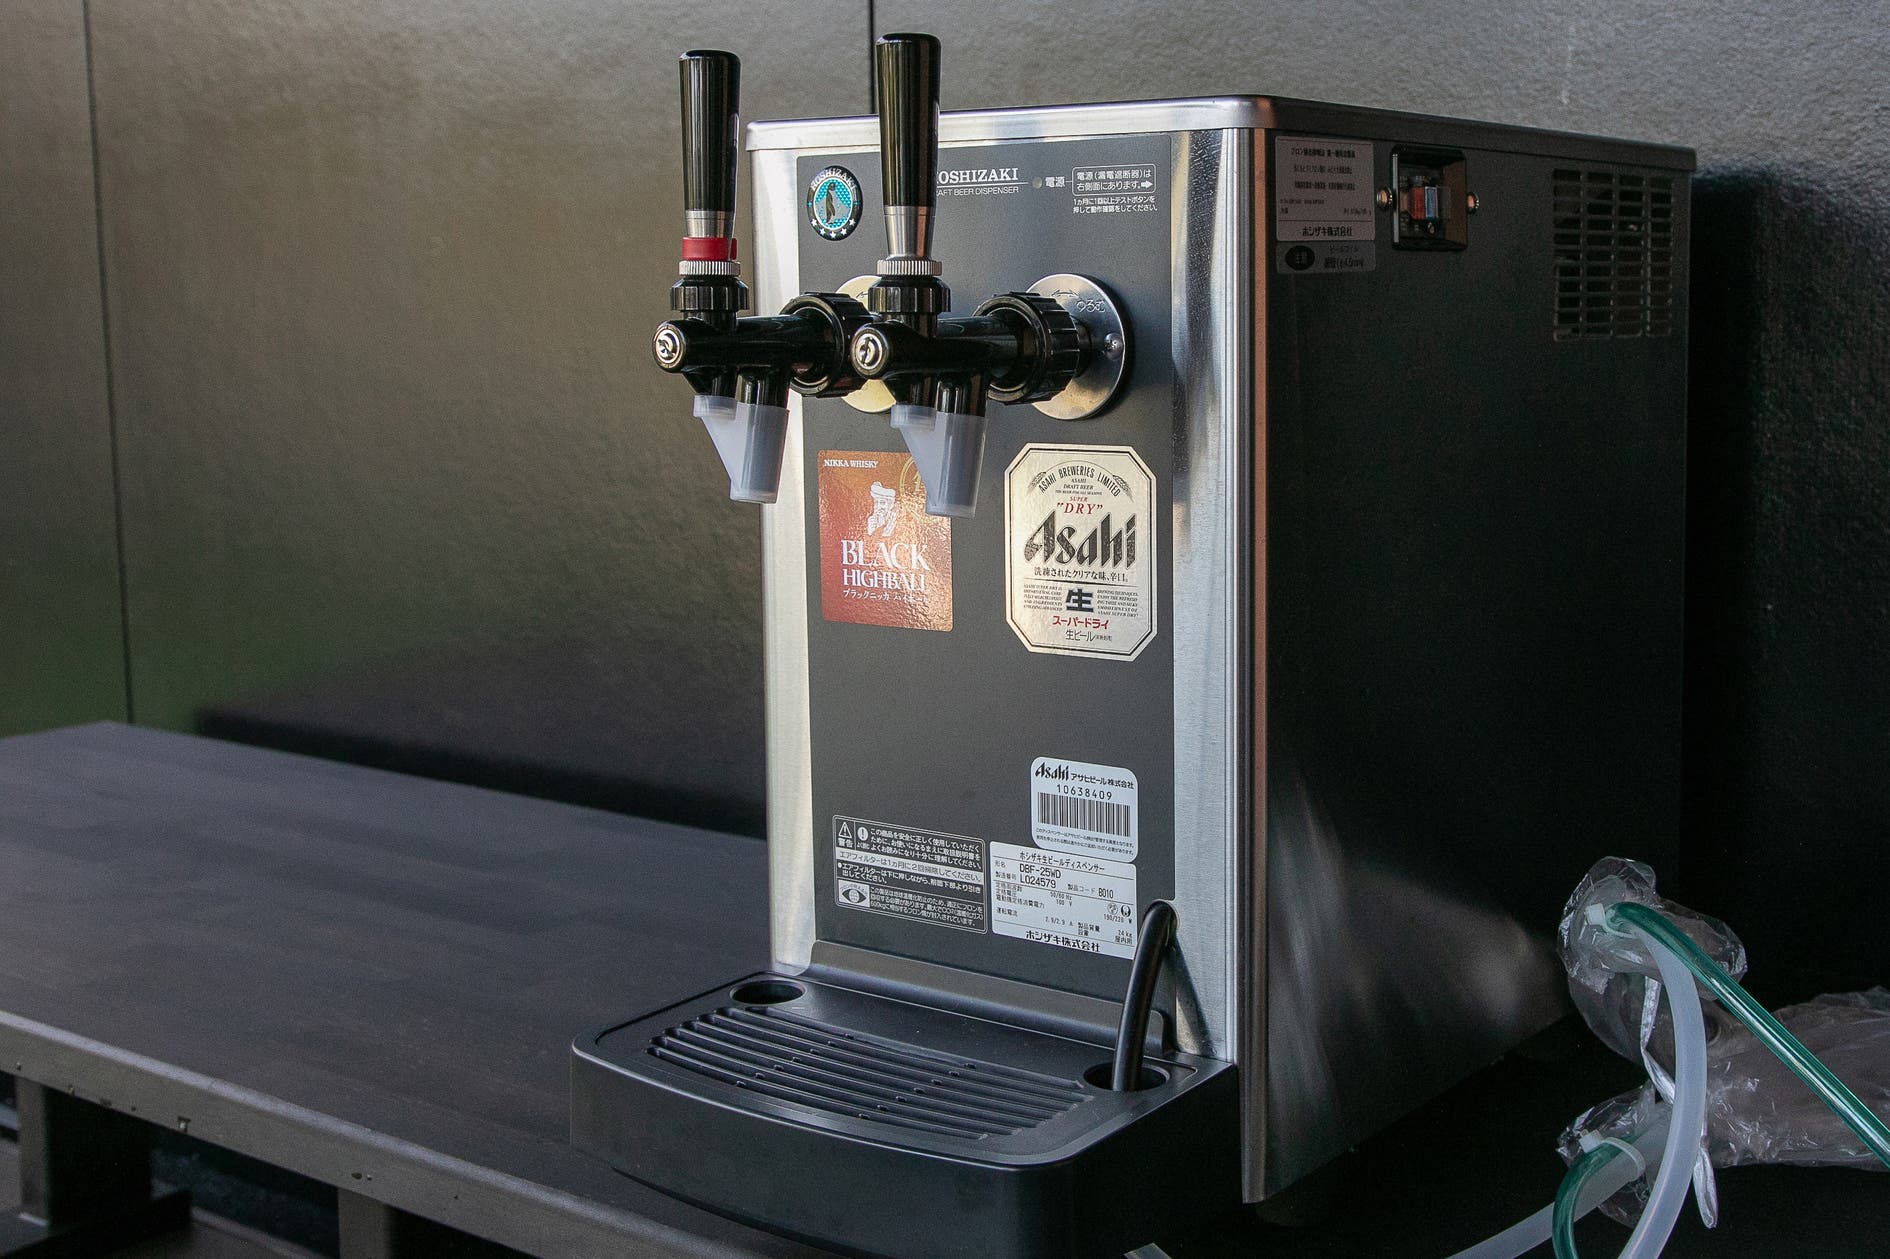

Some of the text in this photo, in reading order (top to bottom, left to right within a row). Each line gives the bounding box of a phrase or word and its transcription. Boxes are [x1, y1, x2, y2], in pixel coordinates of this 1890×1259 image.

[937, 168, 1018, 184] OSHIZAKI
[1045, 177, 1065, 188] 電源
[954, 188, 974, 196] BEER
[975, 186, 1019, 195] DISPENSER
[1303, 226, 1352, 237] ホシザキ株式会社
[824, 459, 878, 469] NIKKA WHISKY
[1038, 465, 1121, 497] ASAHI BREWERIES LIMITED
[1023, 510, 1137, 570] Asahi
[841, 540, 930, 571] BLACK
[843, 569, 926, 593] HIGHBALL
[843, 588, 890, 601] ブラックニッカ
[1065, 588, 1094, 613] 生
[1052, 616, 1109, 630] スーパードライ
[1065, 629, 1095, 642] 生ビール
[1035, 762, 1134, 790] Asahi アサヒビール株式会社
[1057, 784, 1112, 801] 10638409
[838, 838, 853, 848] 警告
[1020, 851, 1105, 873] ホシザキ生ビールディスペンサー
[1020, 863, 1061, 879] DBF-25WD
[1026, 930, 1100, 952] ホシザキ株式会社
